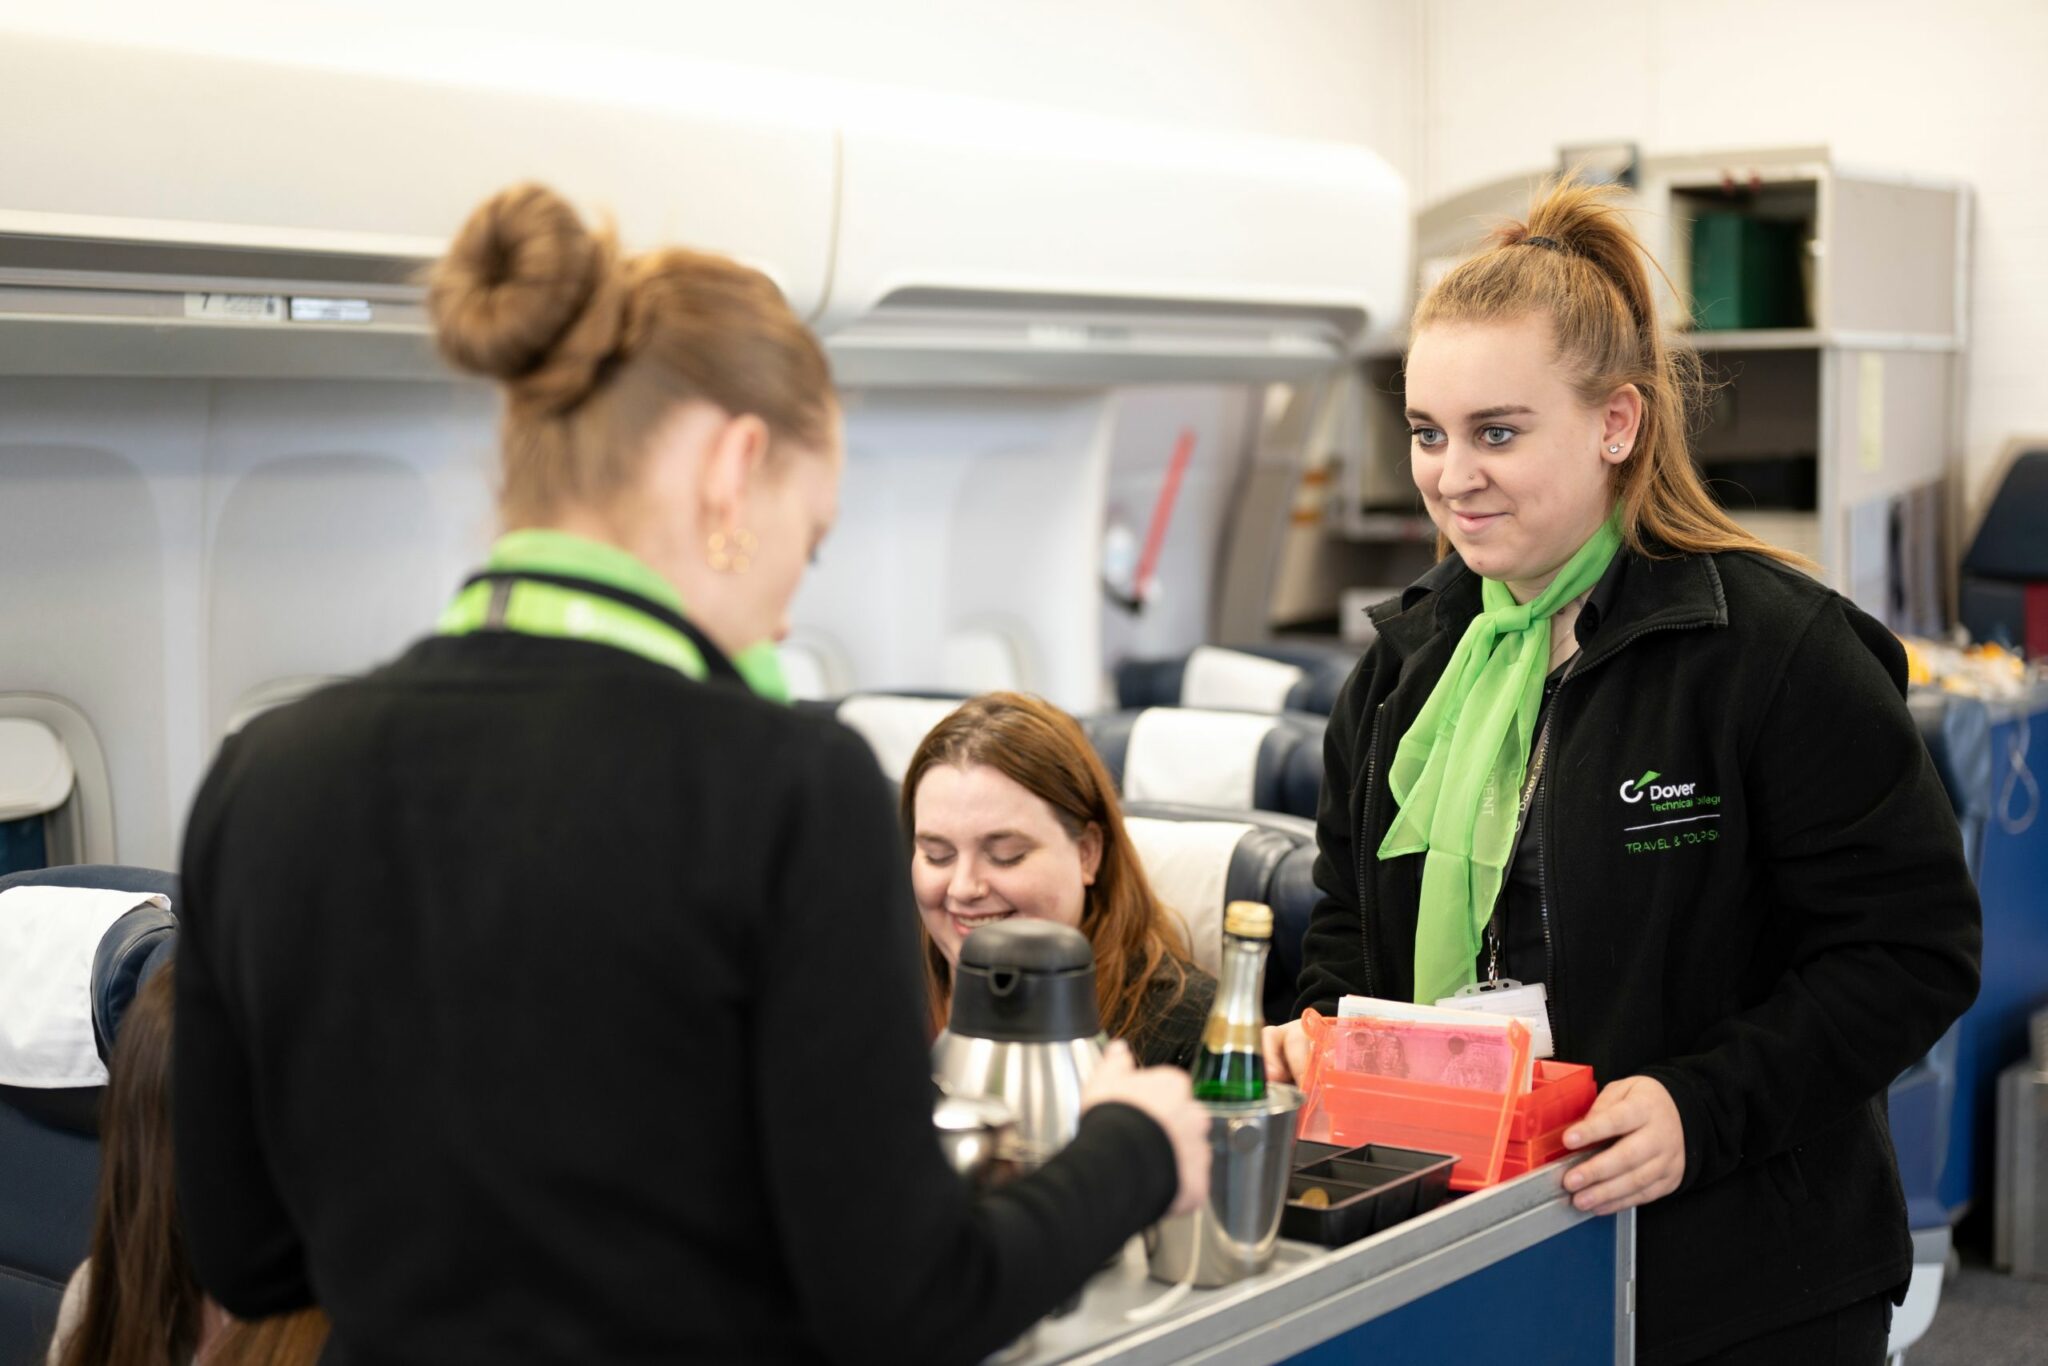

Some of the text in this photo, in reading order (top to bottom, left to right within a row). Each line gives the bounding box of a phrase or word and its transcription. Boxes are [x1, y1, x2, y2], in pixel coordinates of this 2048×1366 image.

[1482, 771, 1494, 816] DENT
[1519, 774, 1537, 811] Dover
[1650, 782, 1696, 801] Dover
[1651, 796, 1721, 812] Technical olleg
[1625, 829, 1720, 854] TRAVEL & TOURS
